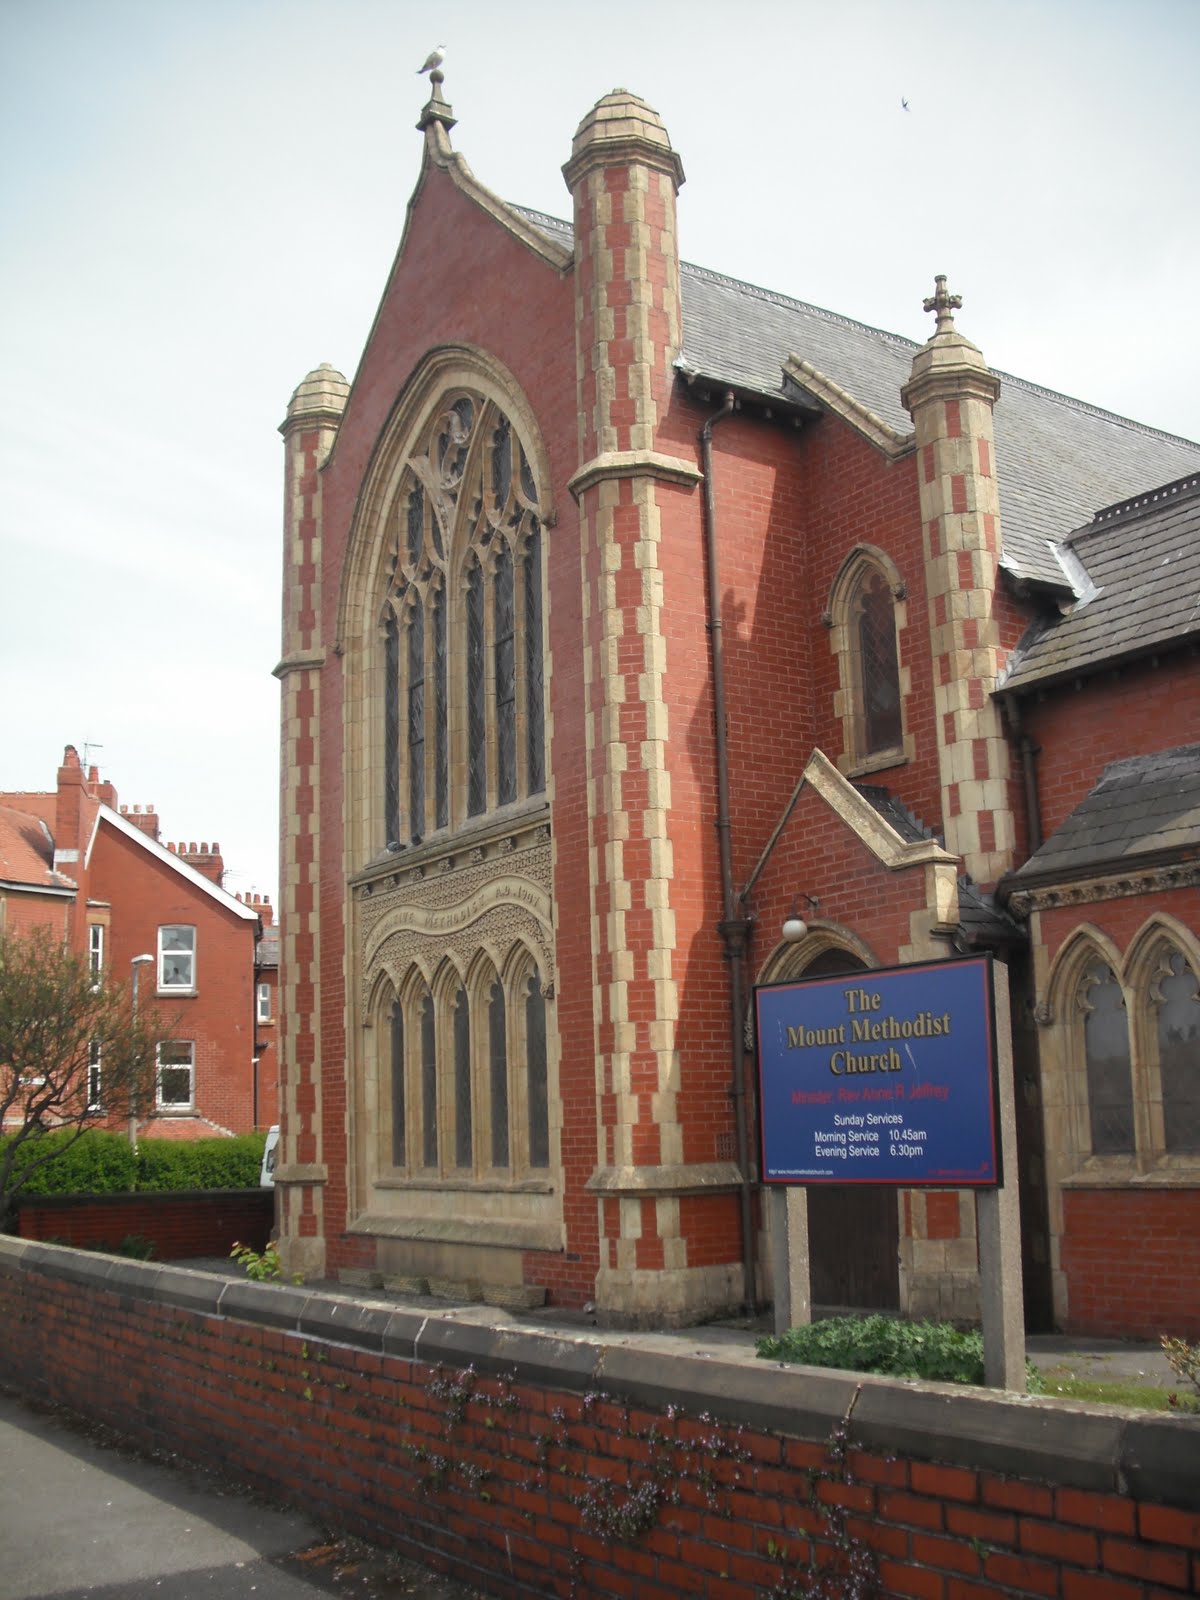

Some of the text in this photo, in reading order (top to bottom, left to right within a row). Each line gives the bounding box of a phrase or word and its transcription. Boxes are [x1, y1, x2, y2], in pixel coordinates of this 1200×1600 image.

[844, 988, 881, 1013] The
[787, 1011, 951, 1048] Mount Methodist
[830, 1047, 902, 1075] Church
[834, 1113, 903, 1128] Sunday Services
[814, 1129, 927, 1145] Morning Service 10.45am
[815, 1144, 923, 1159] Evening Service 6.30pm
